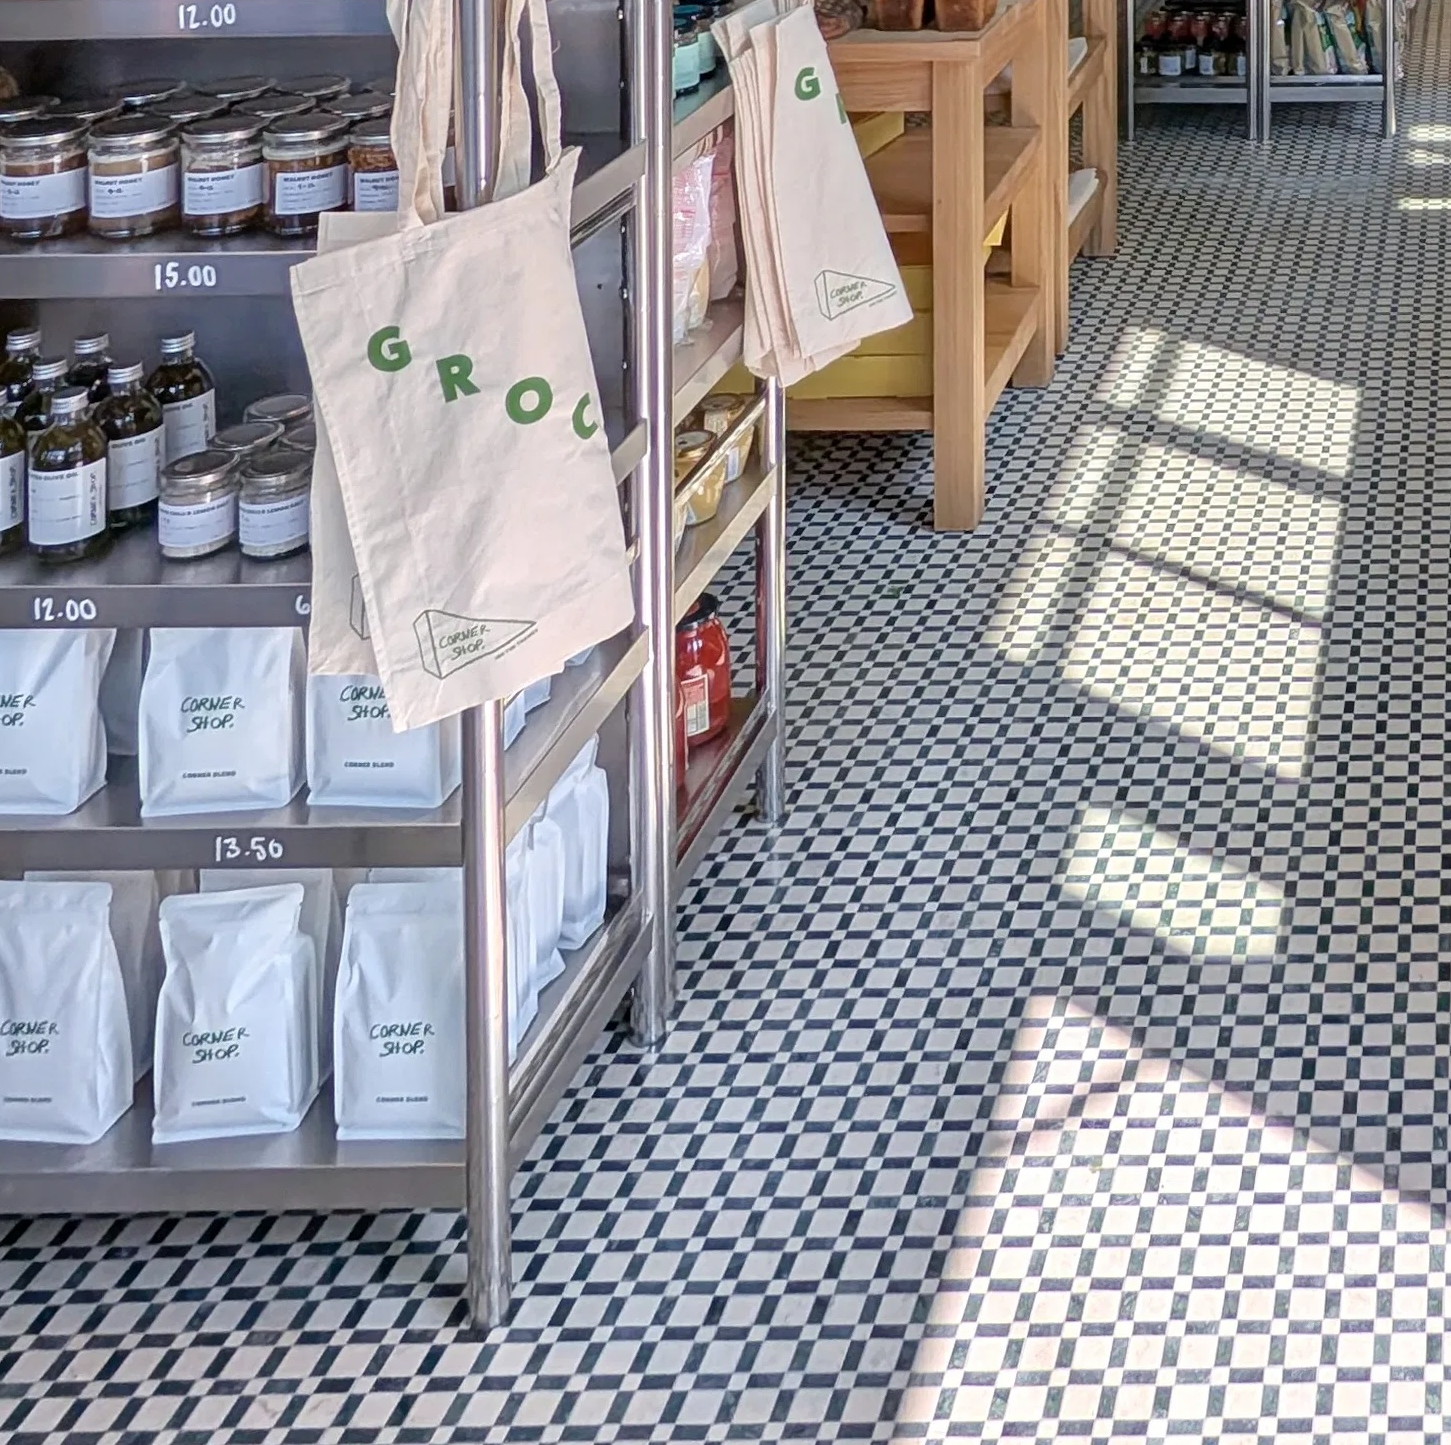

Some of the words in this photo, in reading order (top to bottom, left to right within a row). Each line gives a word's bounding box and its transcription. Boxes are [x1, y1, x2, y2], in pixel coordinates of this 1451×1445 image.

[178, 3, 237, 30] 12.00
[154, 262, 217, 290] 15.00
[34, 597, 97, 622] 12.00
[438, 624, 490, 649] CORNER
[451, 639, 486, 661] SHOP.
[180, 696, 245, 713] CORNER
[186, 714, 235, 733] SHOP.
[0, 1019, 59, 1036] CORNER
[182, 1026, 250, 1047] CORNER
[369, 1021, 435, 1039] CORNER
[5, 1038, 50, 1057] SHOP.
[192, 1044, 240, 1064] SHOP.
[379, 1040, 424, 1058] SHOP.
